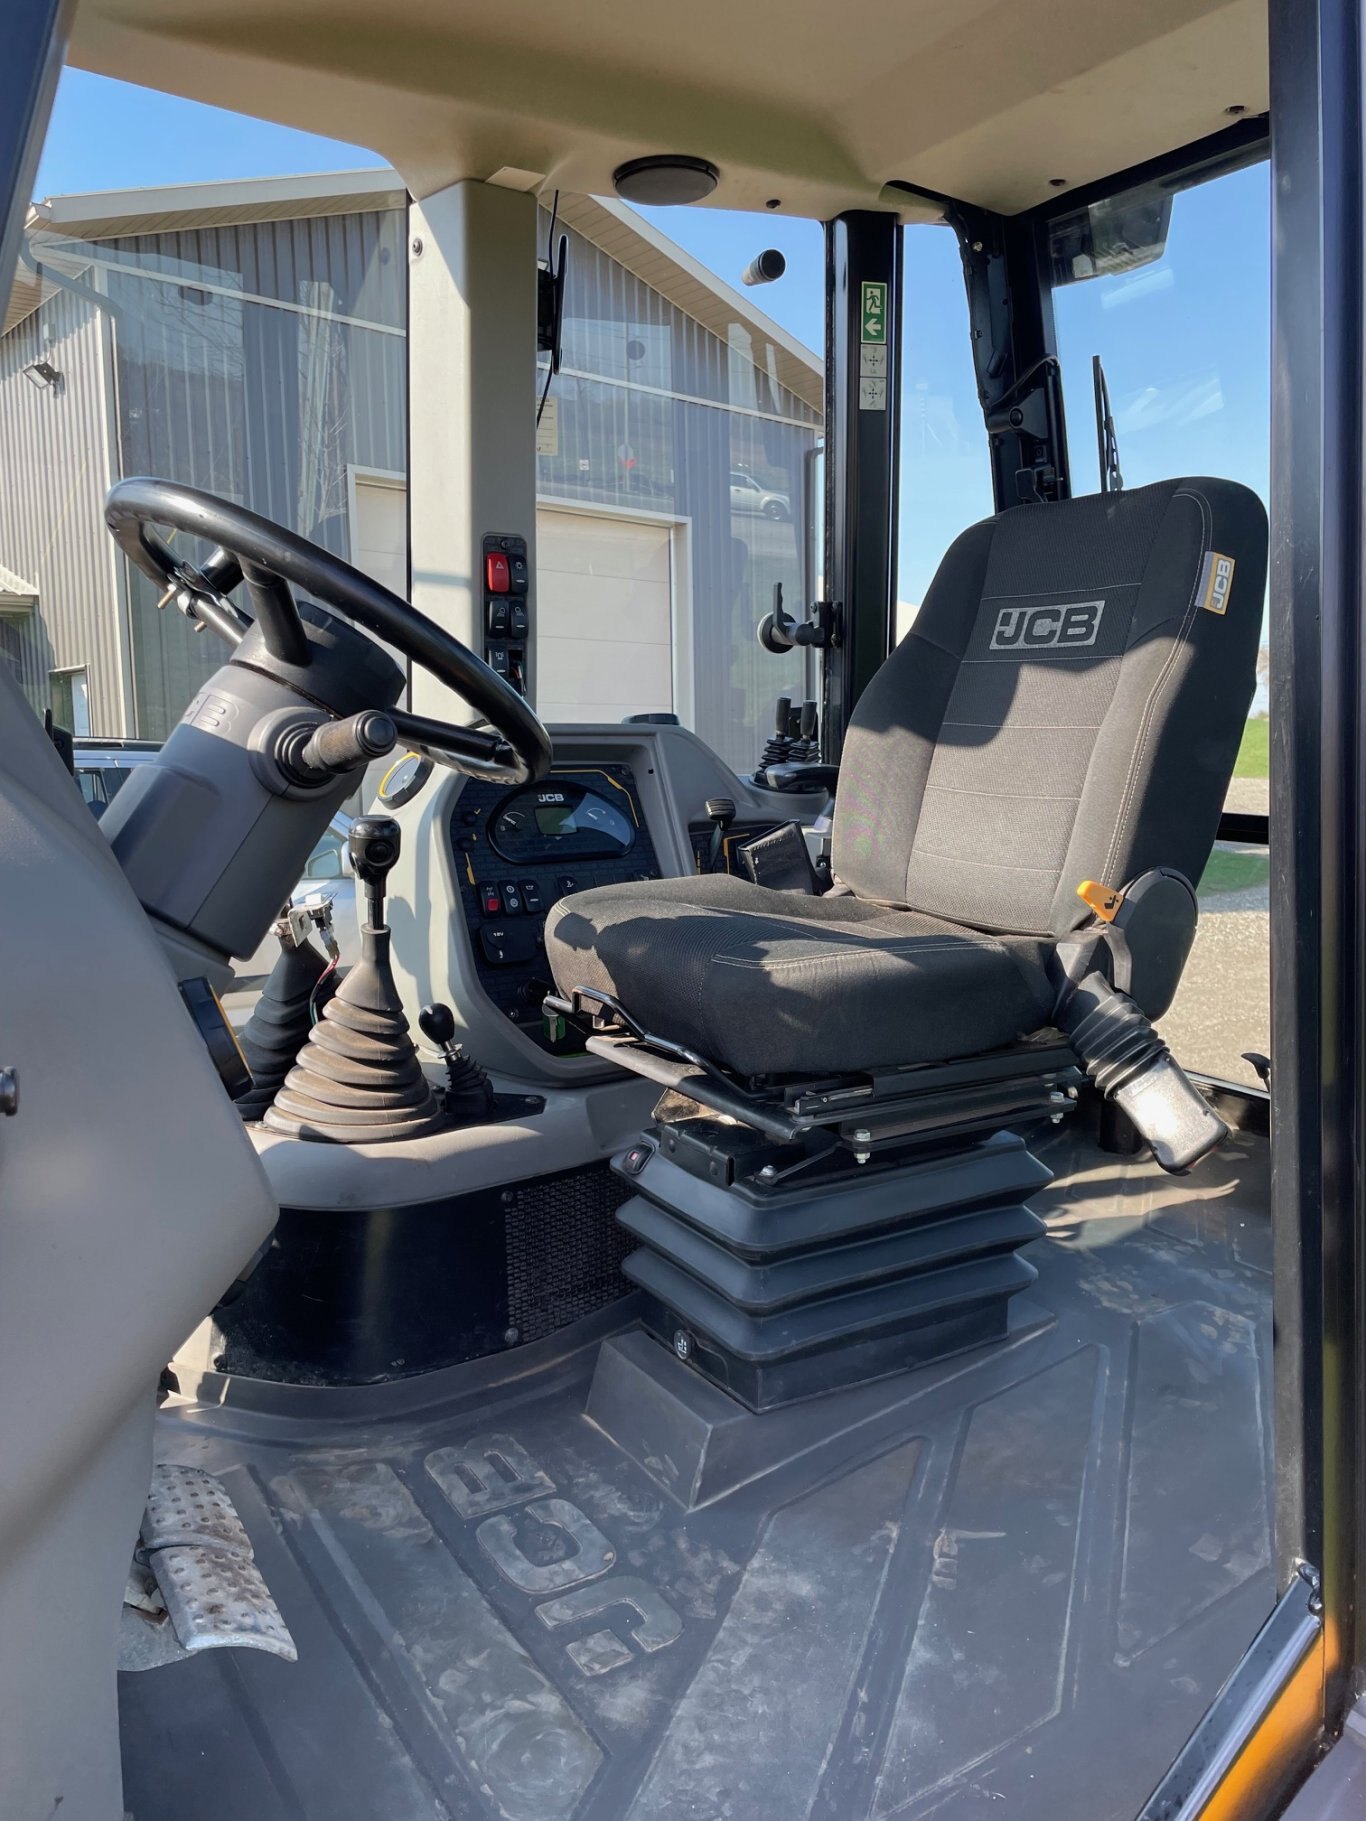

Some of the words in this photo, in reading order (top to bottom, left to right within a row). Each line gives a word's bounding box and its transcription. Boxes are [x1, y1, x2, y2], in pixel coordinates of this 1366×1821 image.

[1211, 559, 1231, 609] JCB
[994, 604, 1101, 647] JCB
[537, 793, 564, 802] JCB
[424, 1433, 685, 1677] JCB
